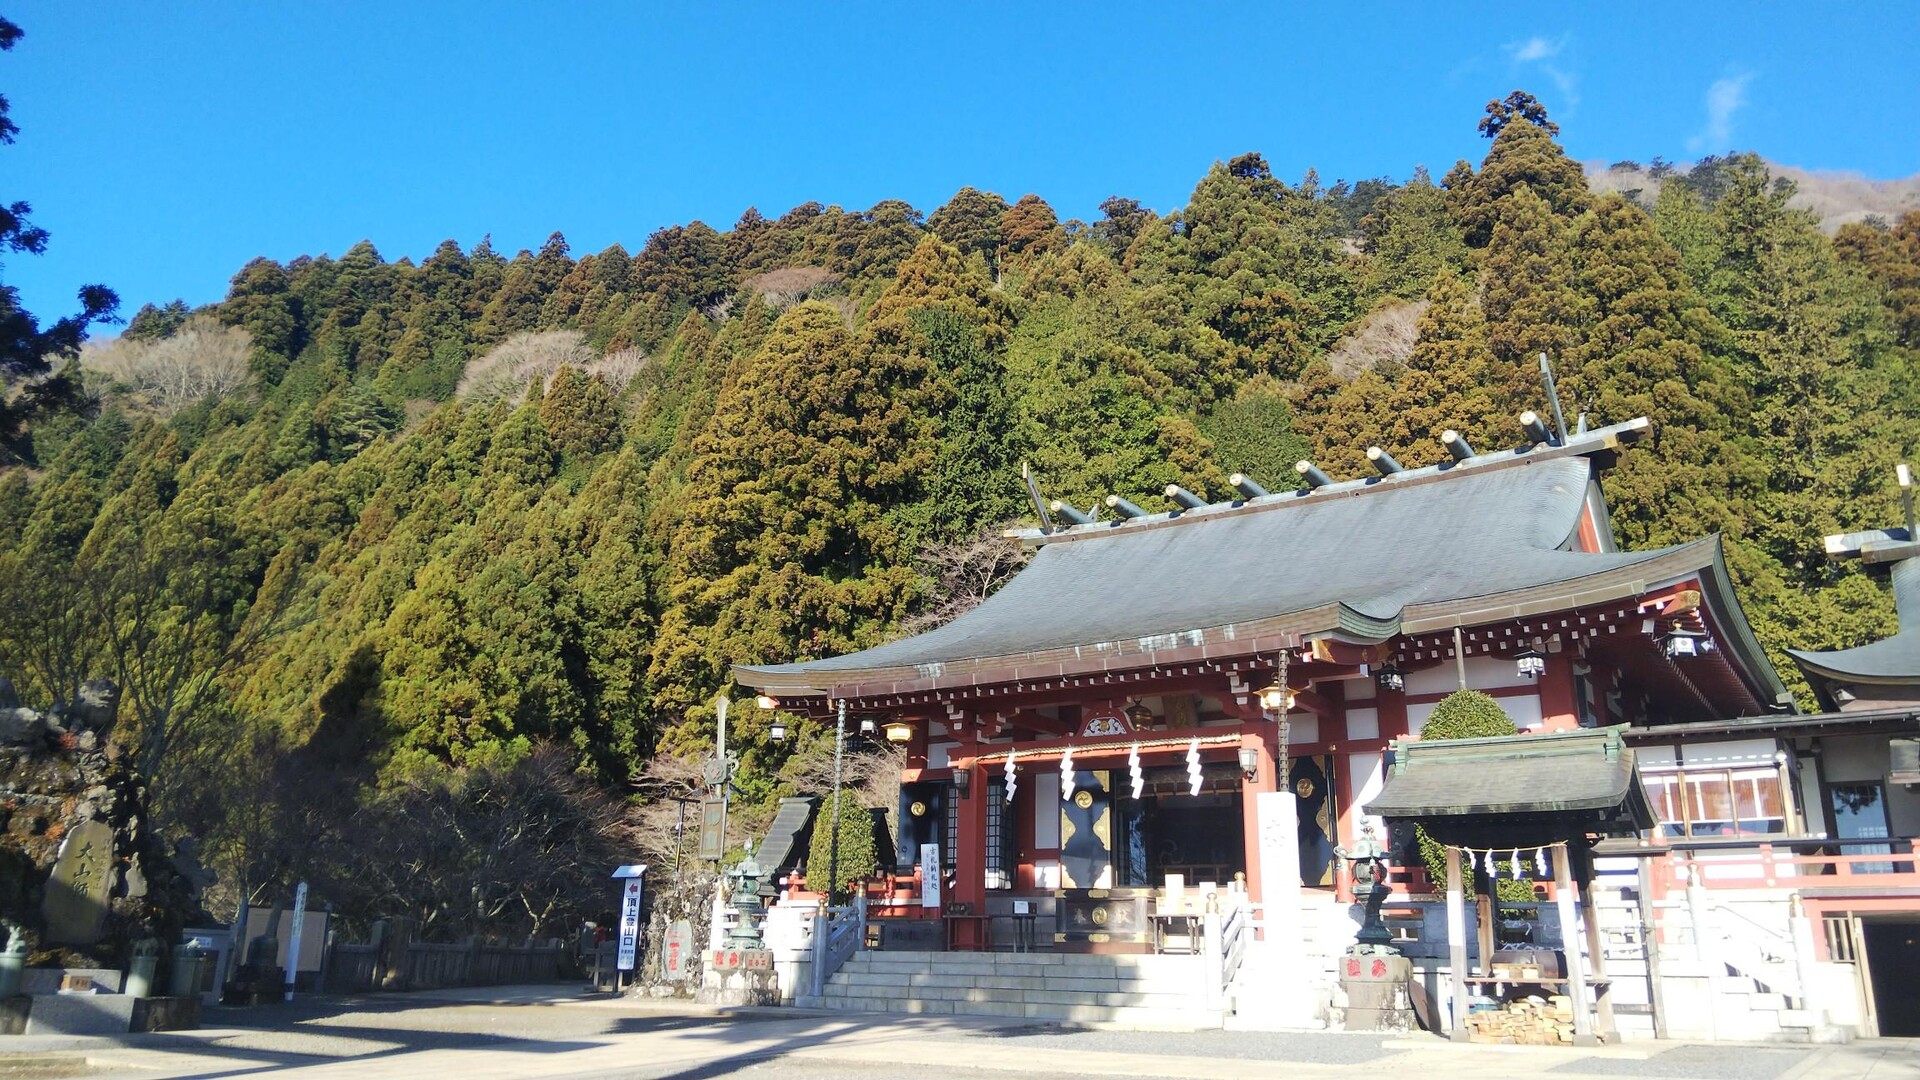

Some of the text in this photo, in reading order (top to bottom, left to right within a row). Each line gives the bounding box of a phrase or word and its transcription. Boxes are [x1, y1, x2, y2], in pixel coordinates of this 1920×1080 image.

[623, 897, 638, 946] 頂上登山口
